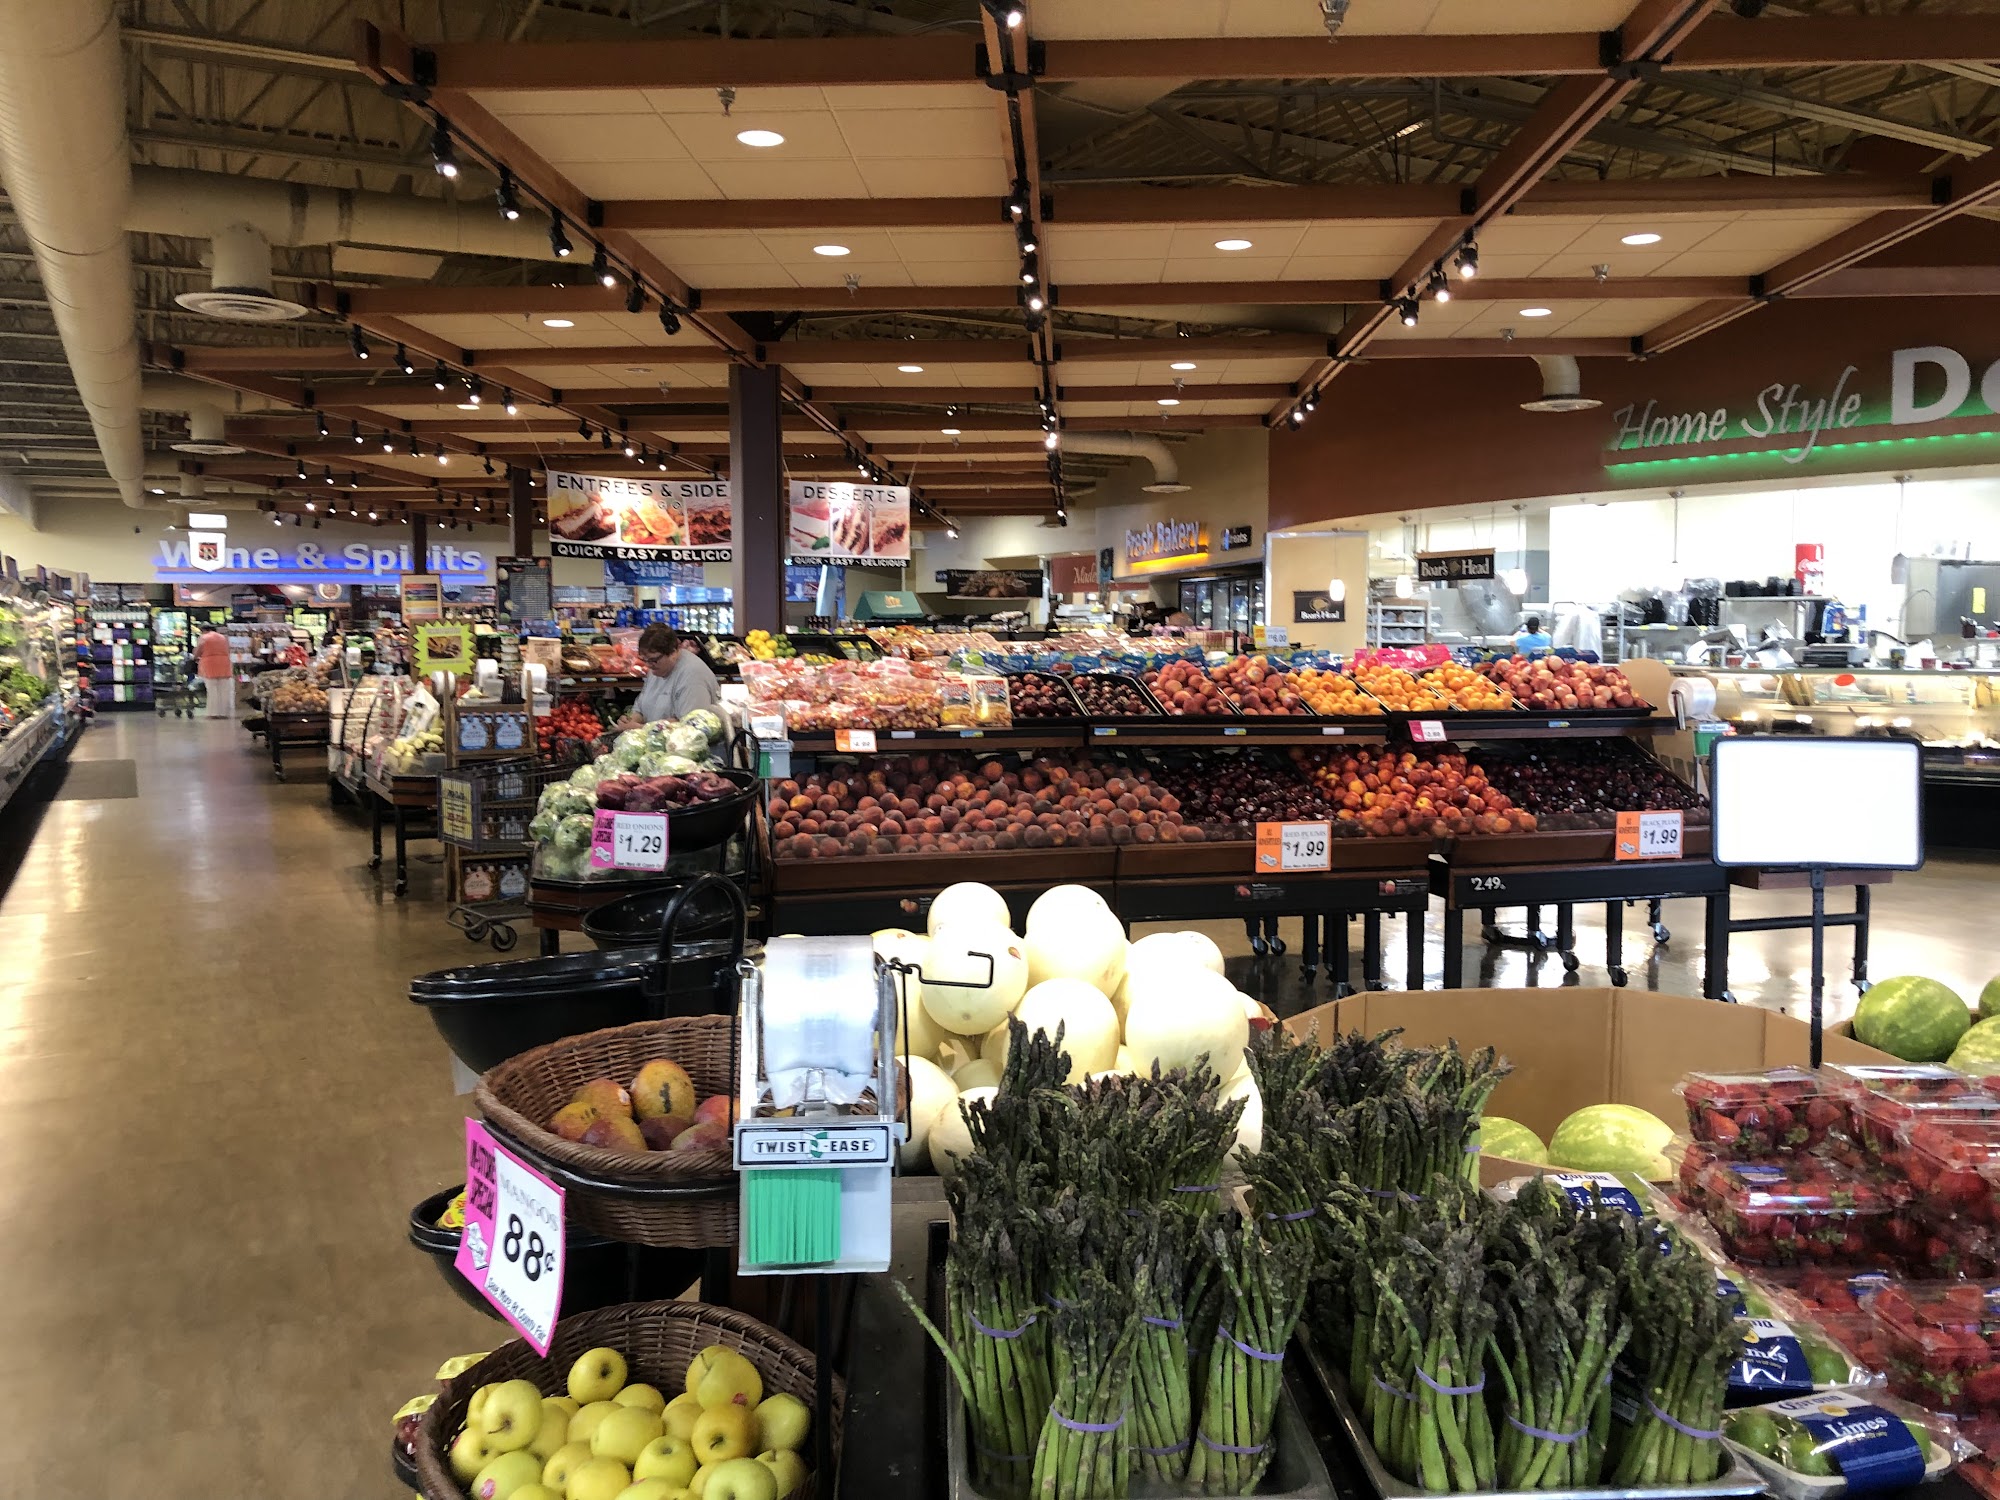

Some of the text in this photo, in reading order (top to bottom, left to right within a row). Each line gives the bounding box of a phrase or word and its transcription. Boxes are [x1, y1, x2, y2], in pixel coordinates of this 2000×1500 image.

[1612, 345, 2000, 464] Home Style D
[557, 474, 653, 496] ENTREES
[661, 484, 672, 498] &
[803, 485, 897, 503] DESSERTS
[1125, 517, 1199, 558] Fresh Bakery
[159, 540, 279, 569] Wne
[296, 542, 326, 569] &
[343, 543, 482, 576] Spiits
[557, 544, 604, 558] QUICK
[616, 548, 658, 560] EASY
[794, 556, 908, 568] QUICK EASY DELICIOUS
[1421, 557, 1490, 577] Boar's Head
[618, 834, 662, 853] $1.29
[1643, 828, 1678, 845] $1.99
[757, 1141, 806, 1153] TWIST
[1824, 1415, 1890, 1438] Limes
